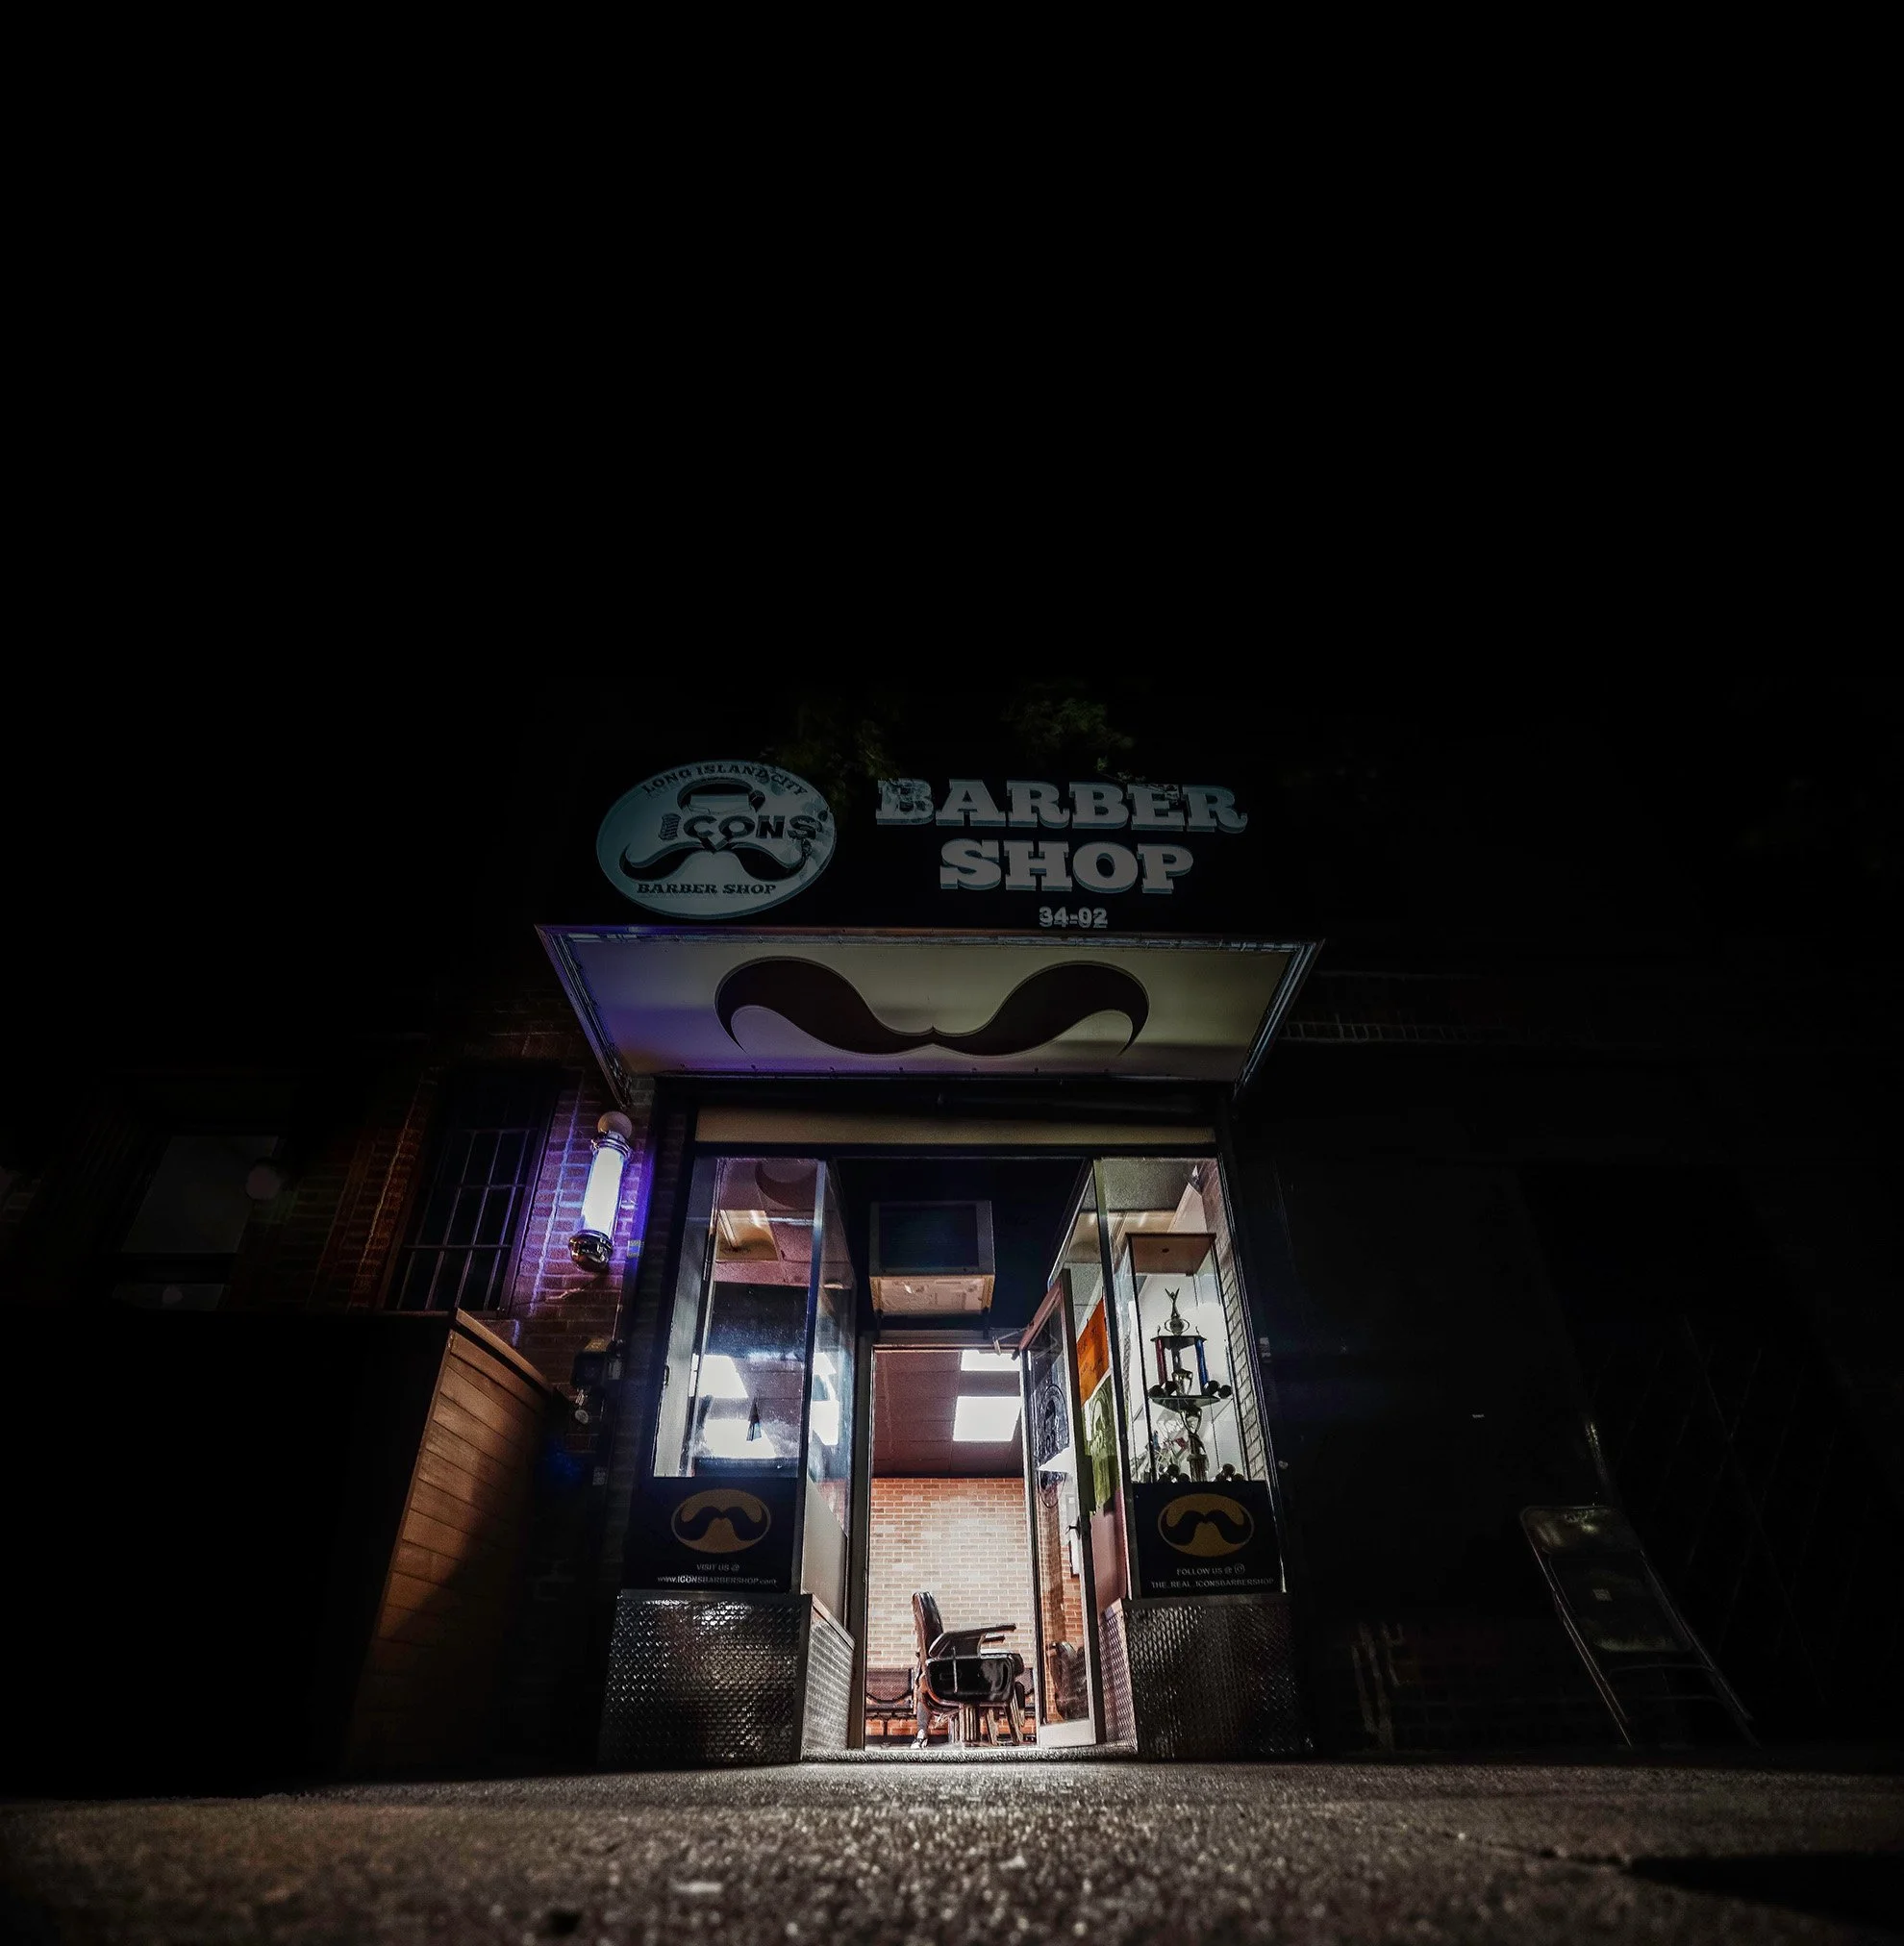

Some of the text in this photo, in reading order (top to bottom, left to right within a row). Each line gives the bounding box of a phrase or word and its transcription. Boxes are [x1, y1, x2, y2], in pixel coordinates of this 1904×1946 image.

[642, 764, 809, 796] LONG ISLAND CITY
[876, 778, 1248, 834] BARBER
[658, 813, 822, 852] ICONS
[939, 838, 1193, 894] SHOP
[637, 883, 776, 895] BARBER SHOP
[1039, 907, 1108, 929] 34-02
[1176, 1567, 1210, 1576] FOLLOW
[1212, 1566, 1223, 1575] US
